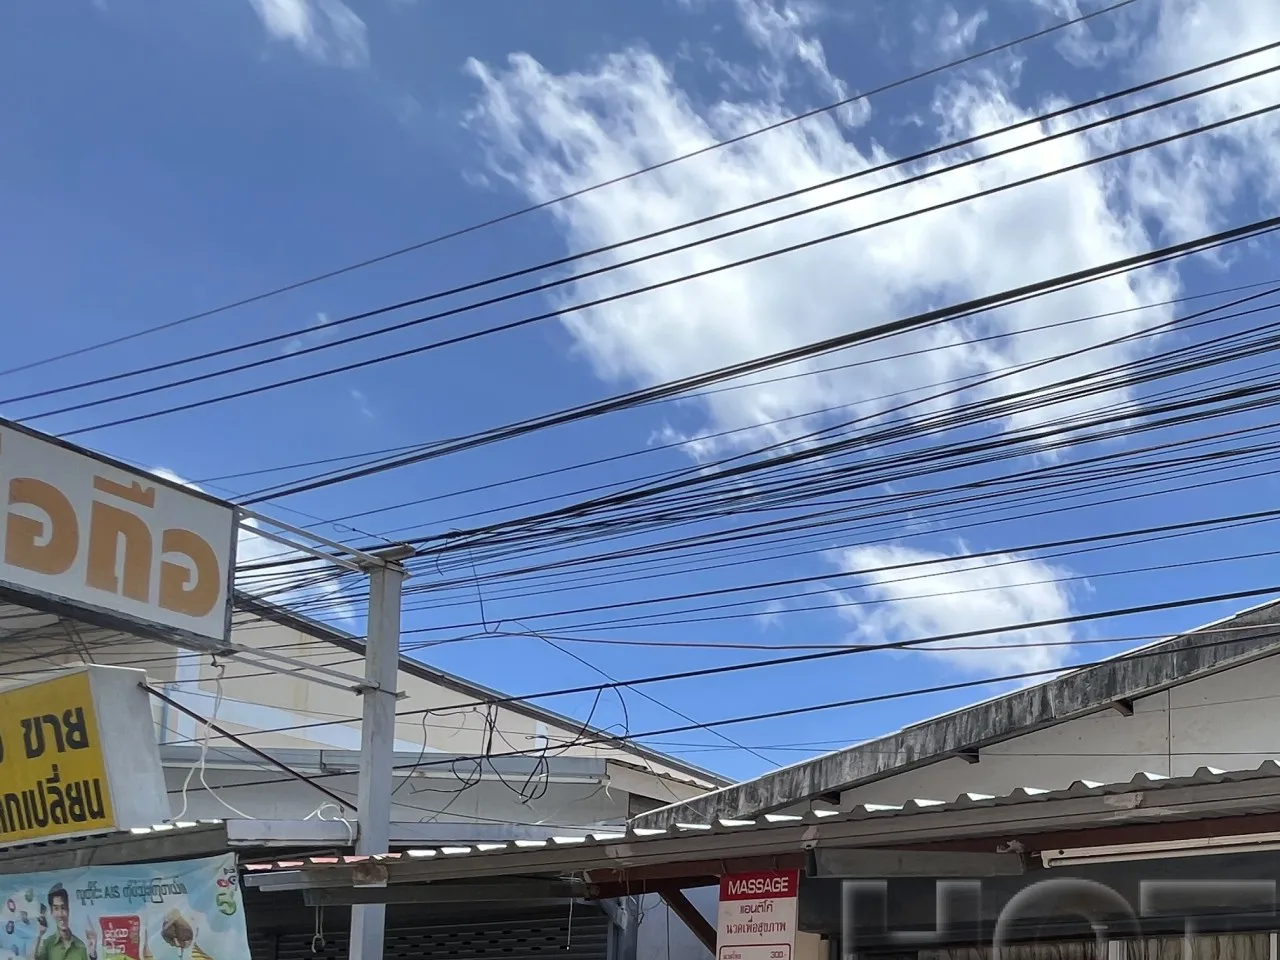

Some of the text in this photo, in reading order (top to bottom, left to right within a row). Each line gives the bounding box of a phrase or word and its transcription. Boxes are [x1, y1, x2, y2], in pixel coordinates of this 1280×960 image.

[1, 474, 221, 618] อถือ
[20, 706, 90, 759] ขาย
[104, 885, 121, 899] AIS
[728, 877, 789, 895] MASSAGE
